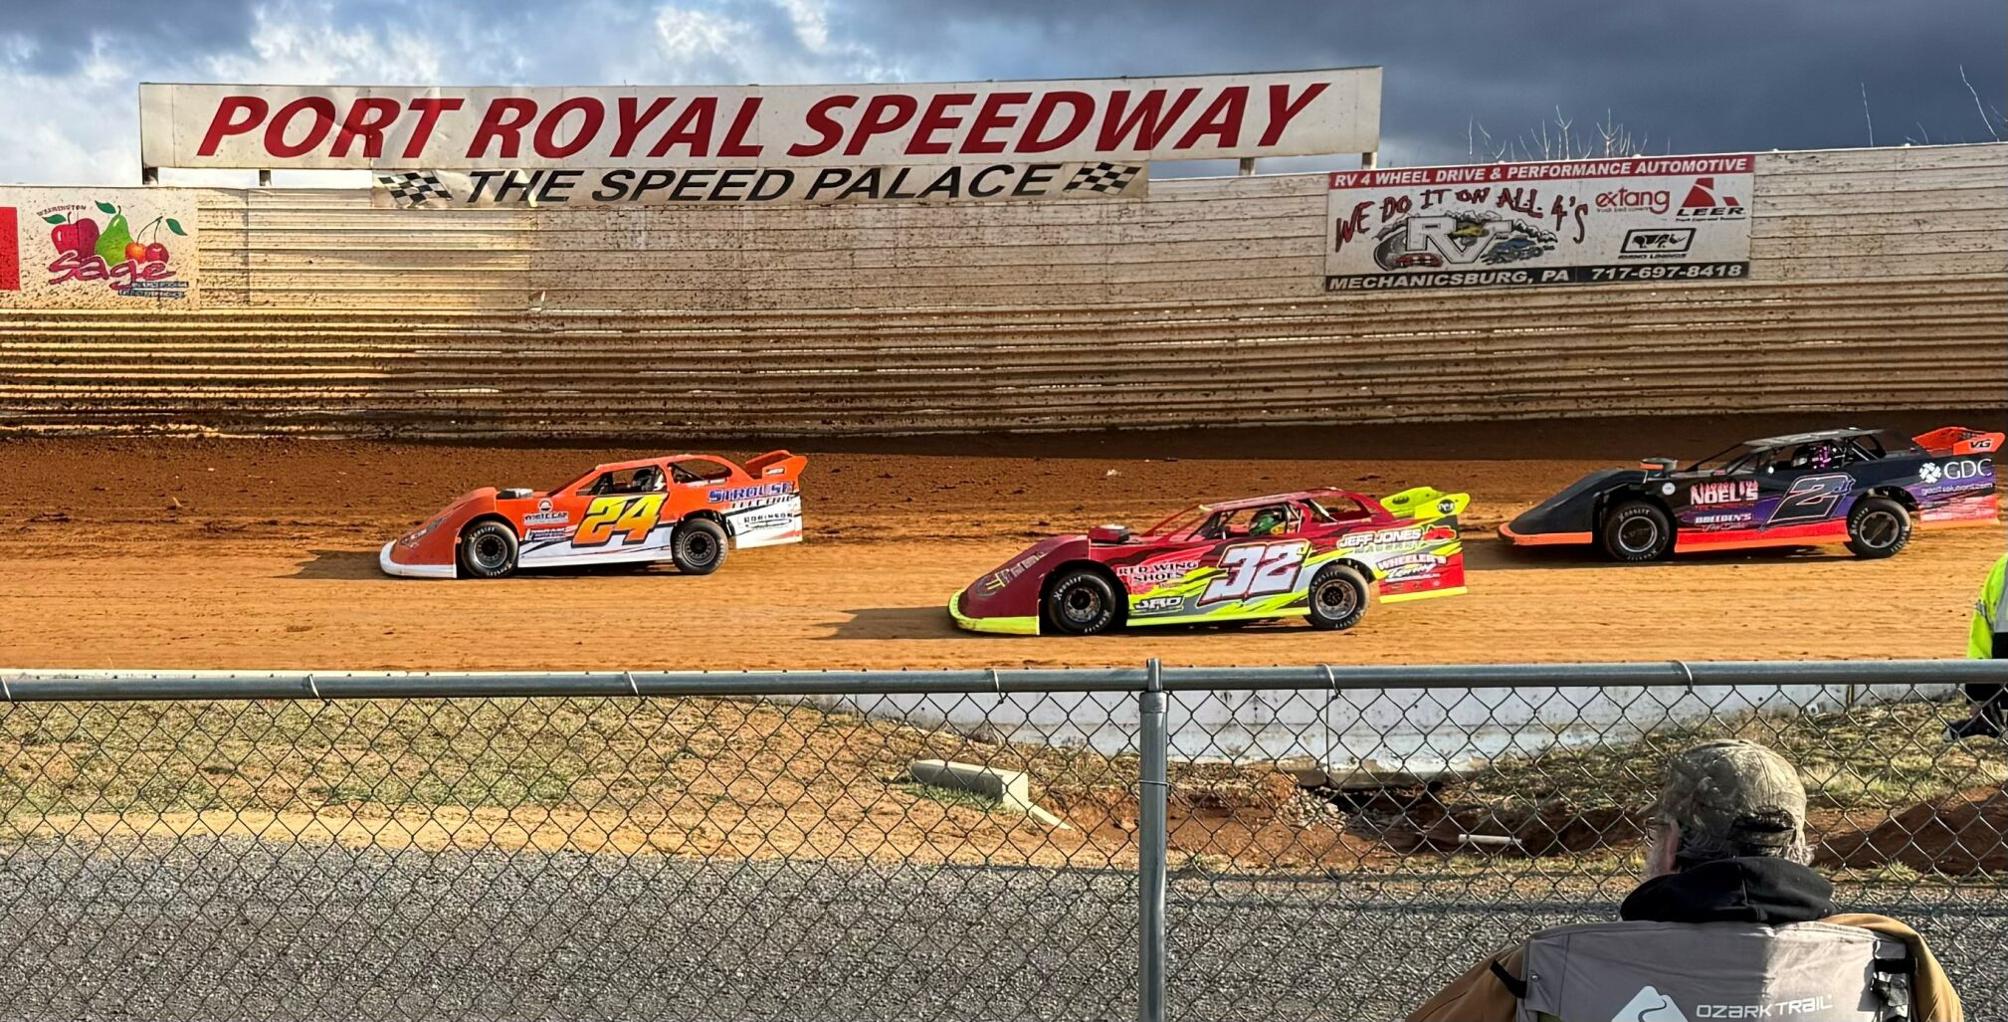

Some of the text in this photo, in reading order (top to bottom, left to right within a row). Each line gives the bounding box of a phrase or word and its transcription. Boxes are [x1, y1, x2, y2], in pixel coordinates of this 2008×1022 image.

[197, 83, 1332, 159] PORT ROYAL SPEEDWAY
[465, 164, 1063, 203] THE SPEED PALACE
[1335, 158, 1747, 187] RV 4 WHEEL DRIVE & PERFORMANCE AUTOMOTIVE
[1595, 187, 1670, 215] extang
[1676, 207, 1745, 217] LEER
[1336, 201, 1375, 252] WE
[1379, 195, 1413, 222] DO
[1420, 188, 1452, 210] IT
[1455, 187, 1490, 204] ON
[48, 249, 177, 291] Sage
[1329, 269, 1569, 290] MECHANICSBURG, PA
[1591, 264, 1743, 281] 717-697-8418
[1944, 459, 1992, 480] GDC
[1691, 480, 1759, 505] NOEL'S
[572, 493, 667, 548] 24
[1340, 529, 1421, 547] JEFF JONES
[1118, 562, 1198, 576] RED WING
[1133, 572, 1185, 582] SHOES
[1198, 542, 1305, 607] 32
